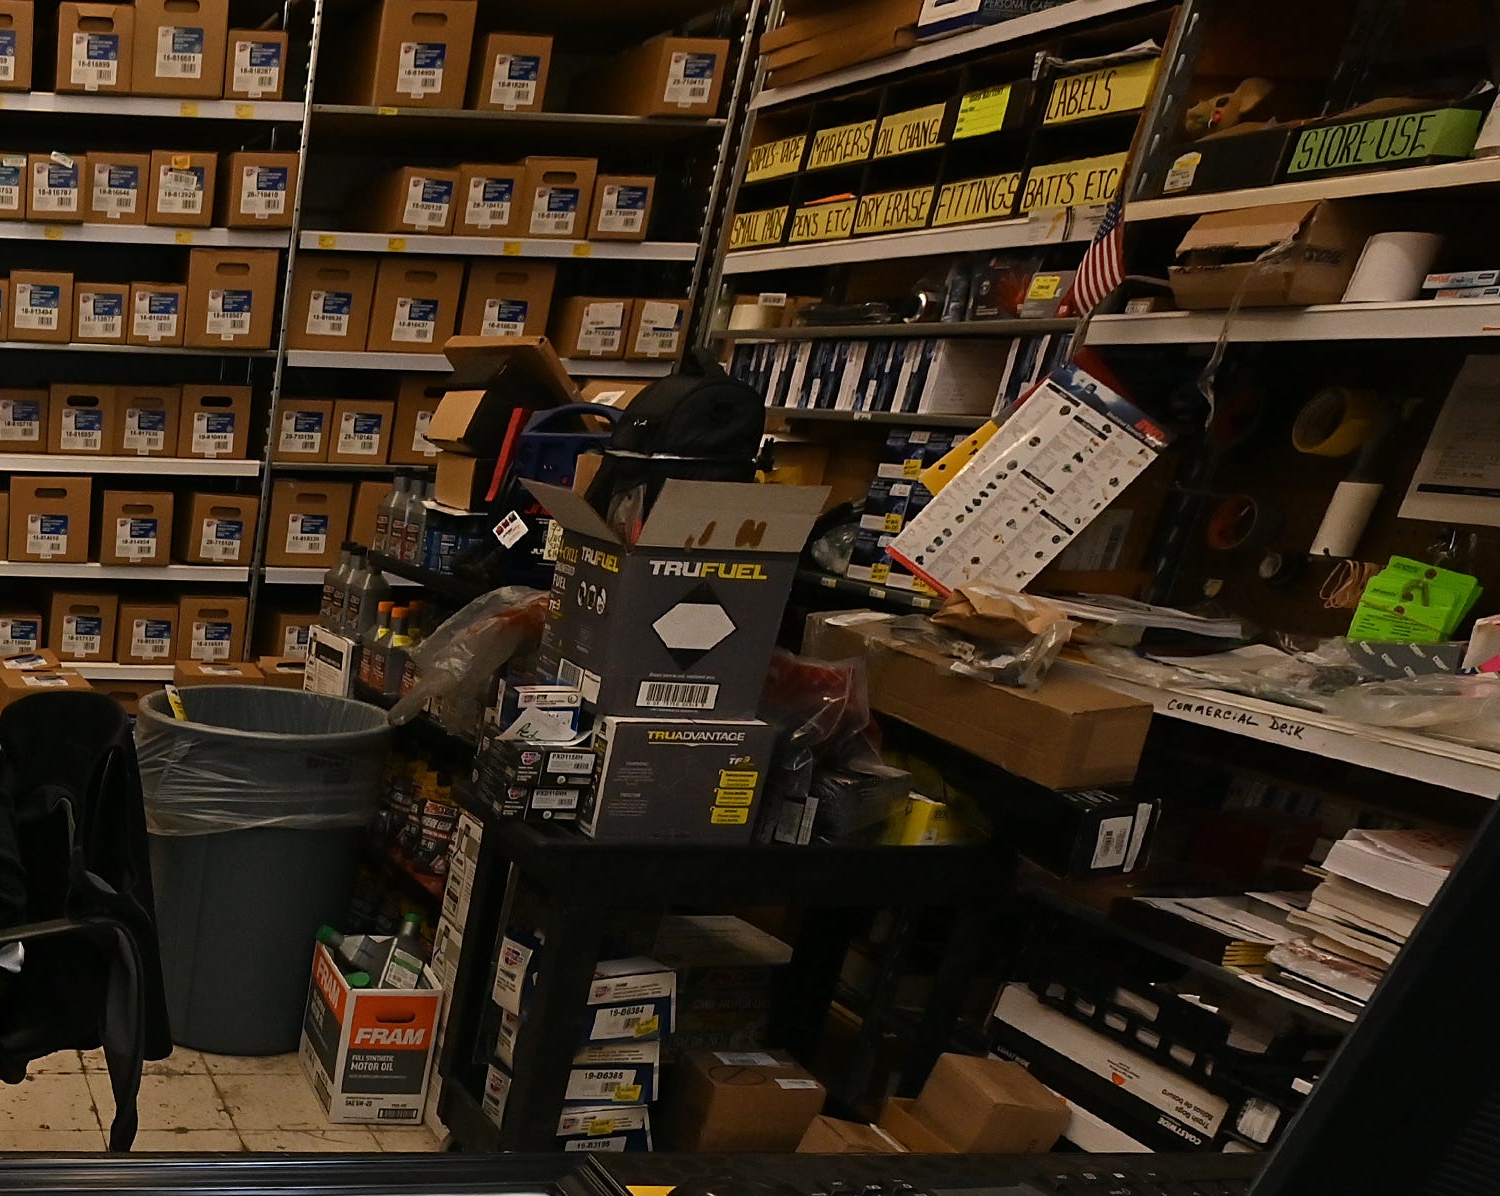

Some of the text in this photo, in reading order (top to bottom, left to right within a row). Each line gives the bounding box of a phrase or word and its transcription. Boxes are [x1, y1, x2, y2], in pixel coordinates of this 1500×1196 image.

[809, 124, 873, 167] MARKERS
[875, 118, 942, 155] OIL CHANG
[934, 174, 1020, 222] FITTINGS
[1084, 168, 1119, 201] ETC
[791, 207, 851, 238] PEN'S ETC
[856, 188, 932, 229] DRY ERASE
[730, 208, 786, 245] SMALL PADS
[581, 546, 620, 574] TRUFUEL
[649, 559, 768, 581] TRUFUEL
[552, 574, 567, 590] FUEL
[647, 730, 747, 742] TRUADVANTAGE
[316, 955, 341, 1010] FRAM
[354, 1027, 426, 1046] FRAM
[350, 1062, 394, 1071] MOTOR OIL
[1156, 1117, 1202, 1146] COASTWIDE
